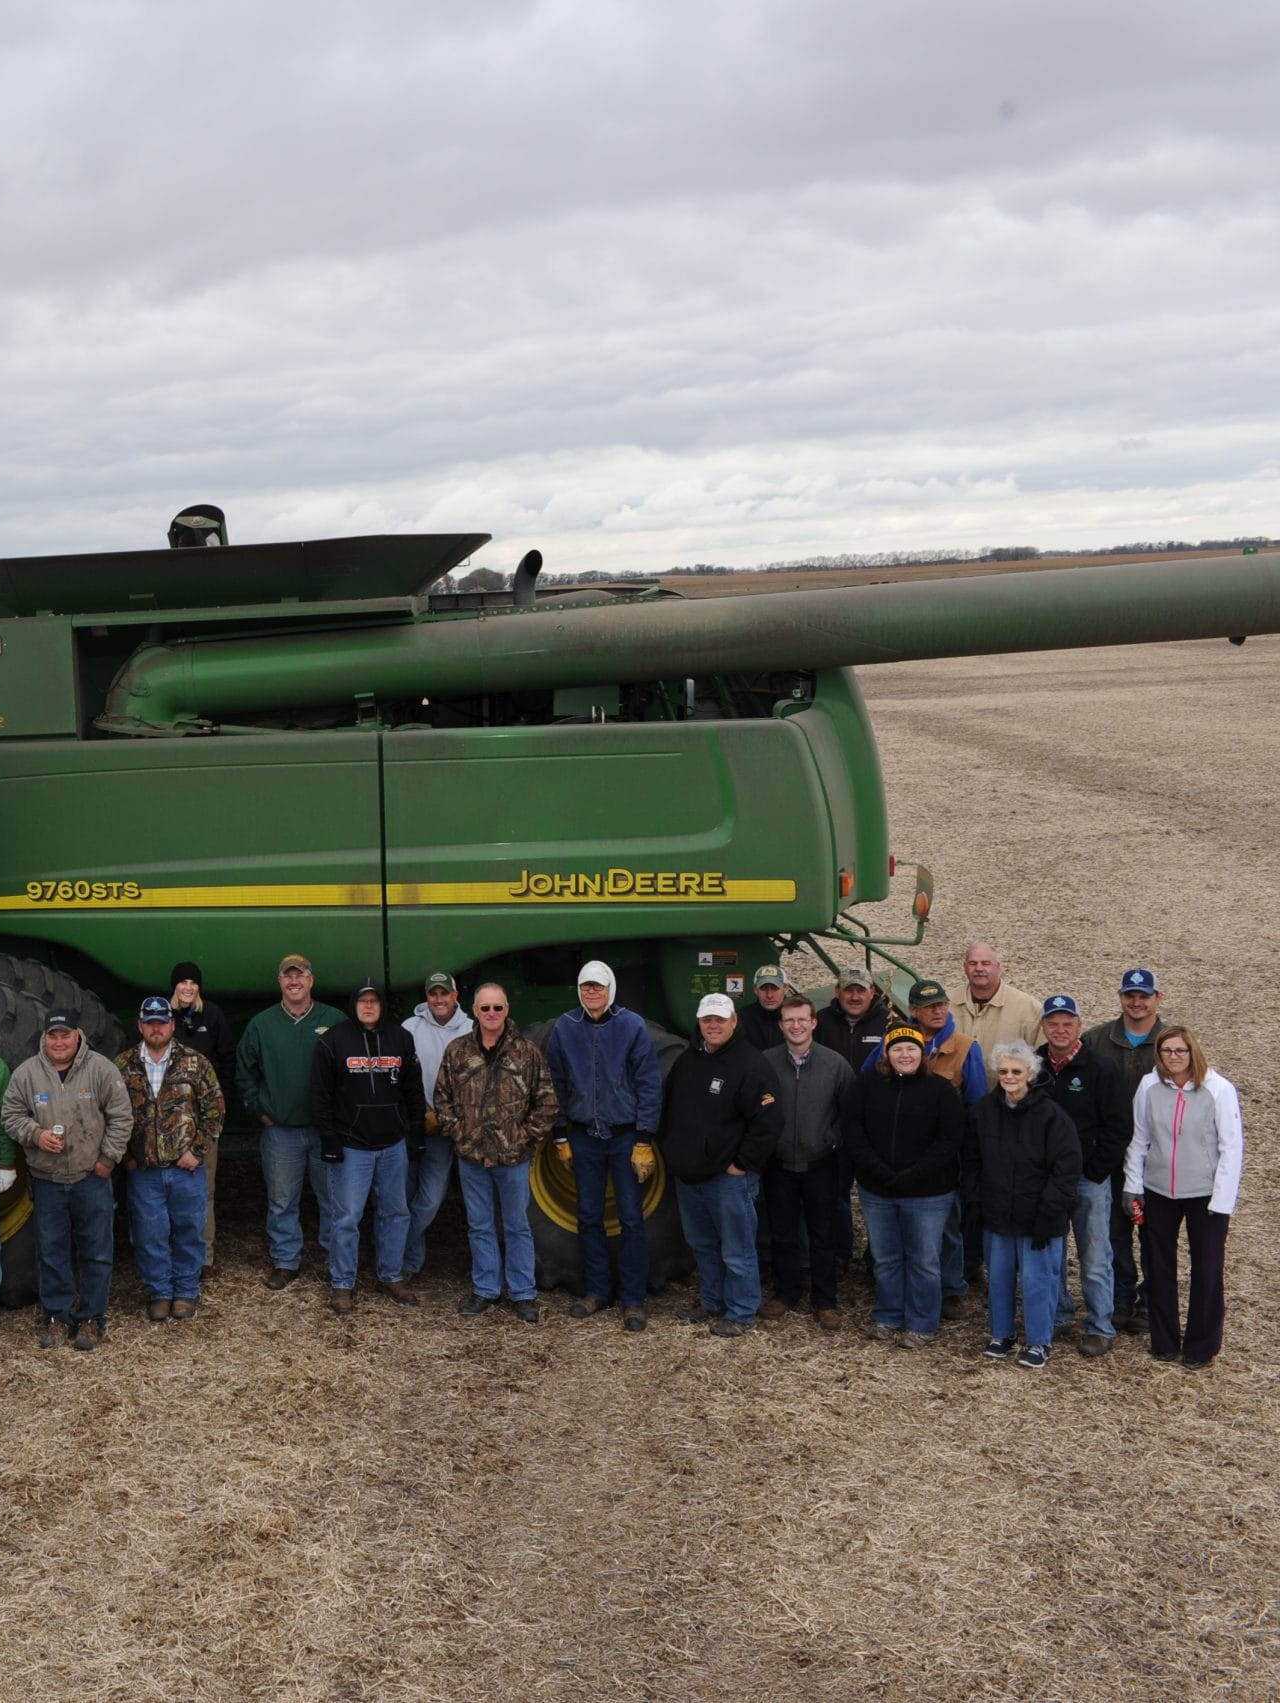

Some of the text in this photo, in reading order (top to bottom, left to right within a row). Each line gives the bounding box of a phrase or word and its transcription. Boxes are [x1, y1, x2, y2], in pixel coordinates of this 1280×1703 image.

[26, 880, 140, 899] 9760STS
[509, 868, 724, 894] JOHN DEERE
[346, 1056, 402, 1068] OWEN
